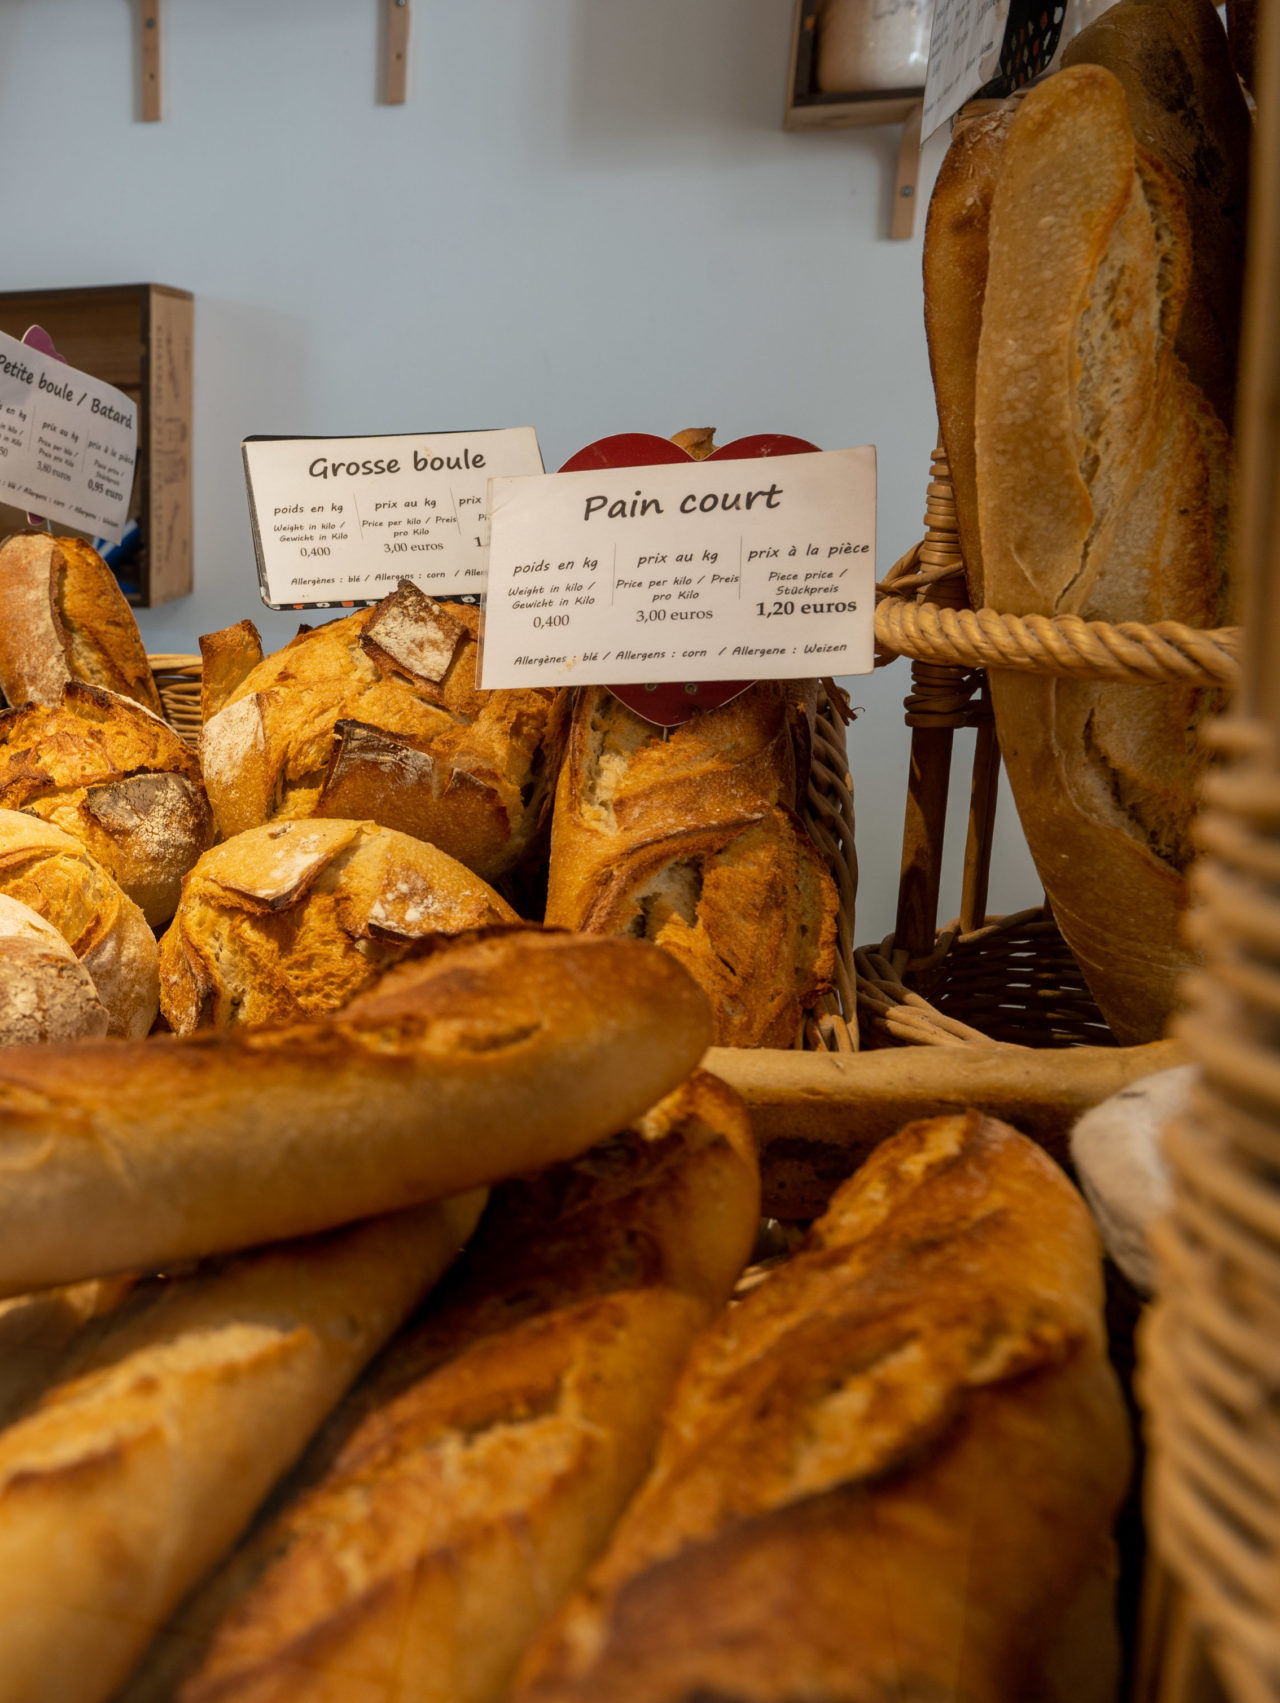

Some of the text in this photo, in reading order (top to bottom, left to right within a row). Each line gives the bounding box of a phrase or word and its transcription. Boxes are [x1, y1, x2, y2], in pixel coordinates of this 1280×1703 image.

[38, 372, 73, 402] boule
[90, 398, 132, 430] Batard
[308, 448, 487, 480] Grosse boule
[87, 479, 123, 501] 0,95 euro
[274, 503, 344, 516] poids en kg
[375, 498, 437, 512] prix au kg
[459, 496, 482, 508] prix
[583, 484, 783, 521] Pain court
[274, 522, 336, 533] Weight in kilo
[362, 516, 457, 528] Price per kilo Preis
[279, 532, 349, 543] Gewicht in Kilo
[393, 528, 430, 538] pro Kilo
[300, 546, 331, 559] 0,400
[383, 542, 444, 554] 3,00 euros
[747, 542, 870, 562] prix à la pièce
[513, 556, 598, 577] poids en kg
[637, 550, 719, 568] prix au kg
[291, 576, 335, 586] Allergènes
[348, 575, 361, 583] blé
[375, 572, 414, 581] Allergens
[426, 571, 445, 579] corn
[615, 574, 739, 590] Price per kilo Preis
[768, 570, 834, 582] Piece price
[508, 582, 583, 597] Weight in kilo
[652, 590, 699, 603] pro Kilo
[775, 583, 839, 597] Stückpreis
[512, 595, 595, 610] Gewicht in Kilo
[756, 600, 857, 619] 1,20 euros
[532, 614, 570, 629] 0,400
[635, 609, 713, 624] 3,00 euros
[514, 643, 848, 667] Allergènes blé Allergens corn Allergene Weizen
